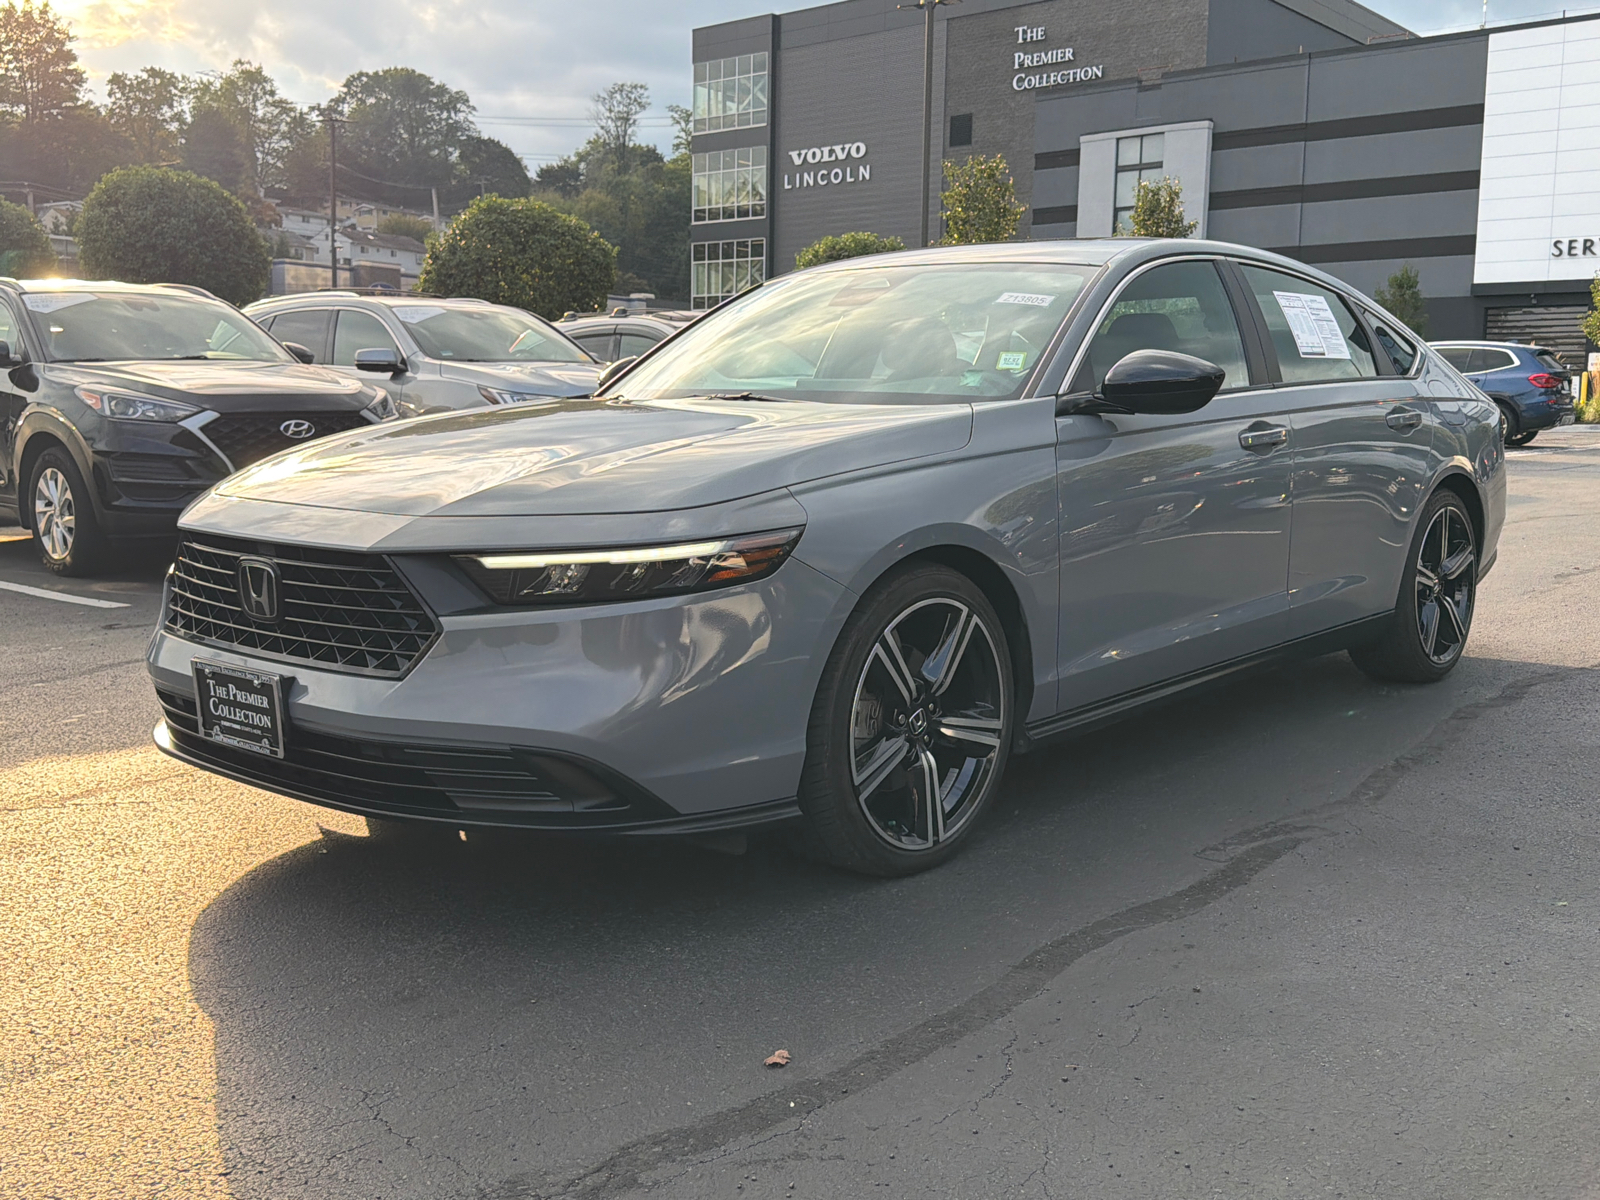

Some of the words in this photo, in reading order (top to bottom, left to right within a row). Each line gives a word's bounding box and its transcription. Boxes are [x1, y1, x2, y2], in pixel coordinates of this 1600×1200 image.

[1014, 25, 1046, 44] THE
[1013, 47, 1075, 69] PREMIER
[1012, 65, 1104, 91] COLLECTION
[789, 141, 867, 166] VOLVO
[784, 164, 871, 190] LINCOLN
[1551, 237, 1600, 258] SER
[206, 679, 228, 699] THE
[228, 683, 270, 709] PREMIER
[209, 697, 272, 729] COLLECTION
